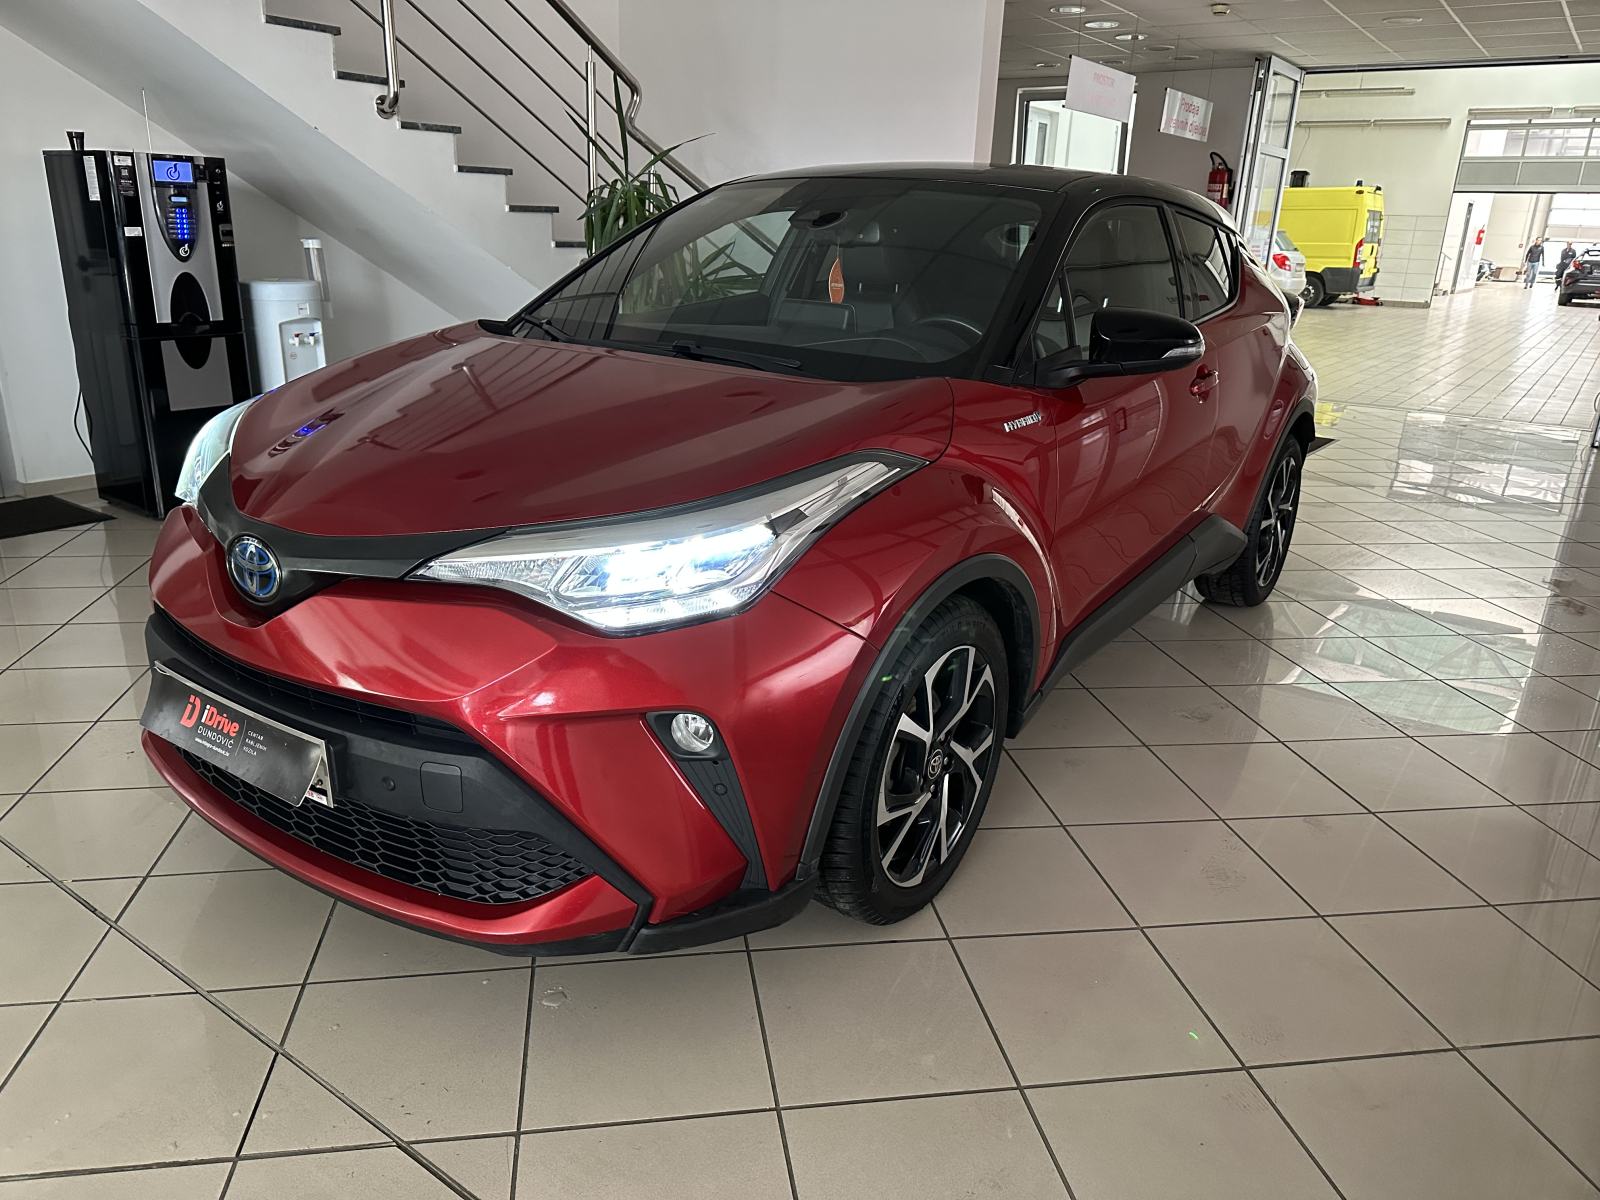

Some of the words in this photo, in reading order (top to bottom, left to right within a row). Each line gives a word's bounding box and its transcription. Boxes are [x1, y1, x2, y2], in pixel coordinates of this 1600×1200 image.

[1181, 97, 1200, 118] Prodaja
[1003, 411, 1041, 433] HYBRID
[201, 704, 240, 737] iDrive
[197, 725, 235, 749] DUNDOVIĆ
[247, 730, 264, 741] CENTAR
[242, 745, 257, 756] VOZILA
